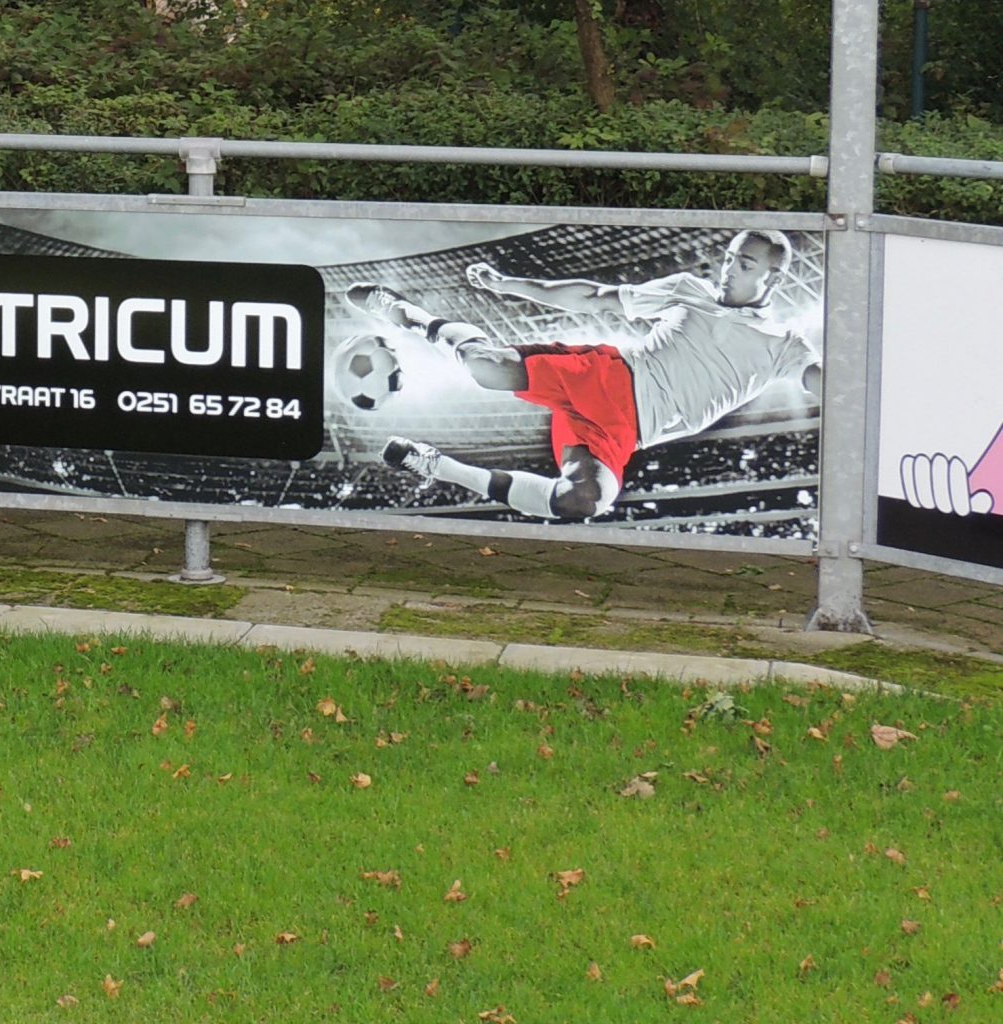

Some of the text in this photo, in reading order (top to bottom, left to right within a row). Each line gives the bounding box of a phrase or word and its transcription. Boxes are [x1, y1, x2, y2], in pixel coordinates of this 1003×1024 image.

[70, 388, 96, 410] 16
[117, 390, 179, 414] 0251
[189, 394, 223, 416] 65
[227, 396, 261, 418] 72
[265, 397, 302, 420] 84
